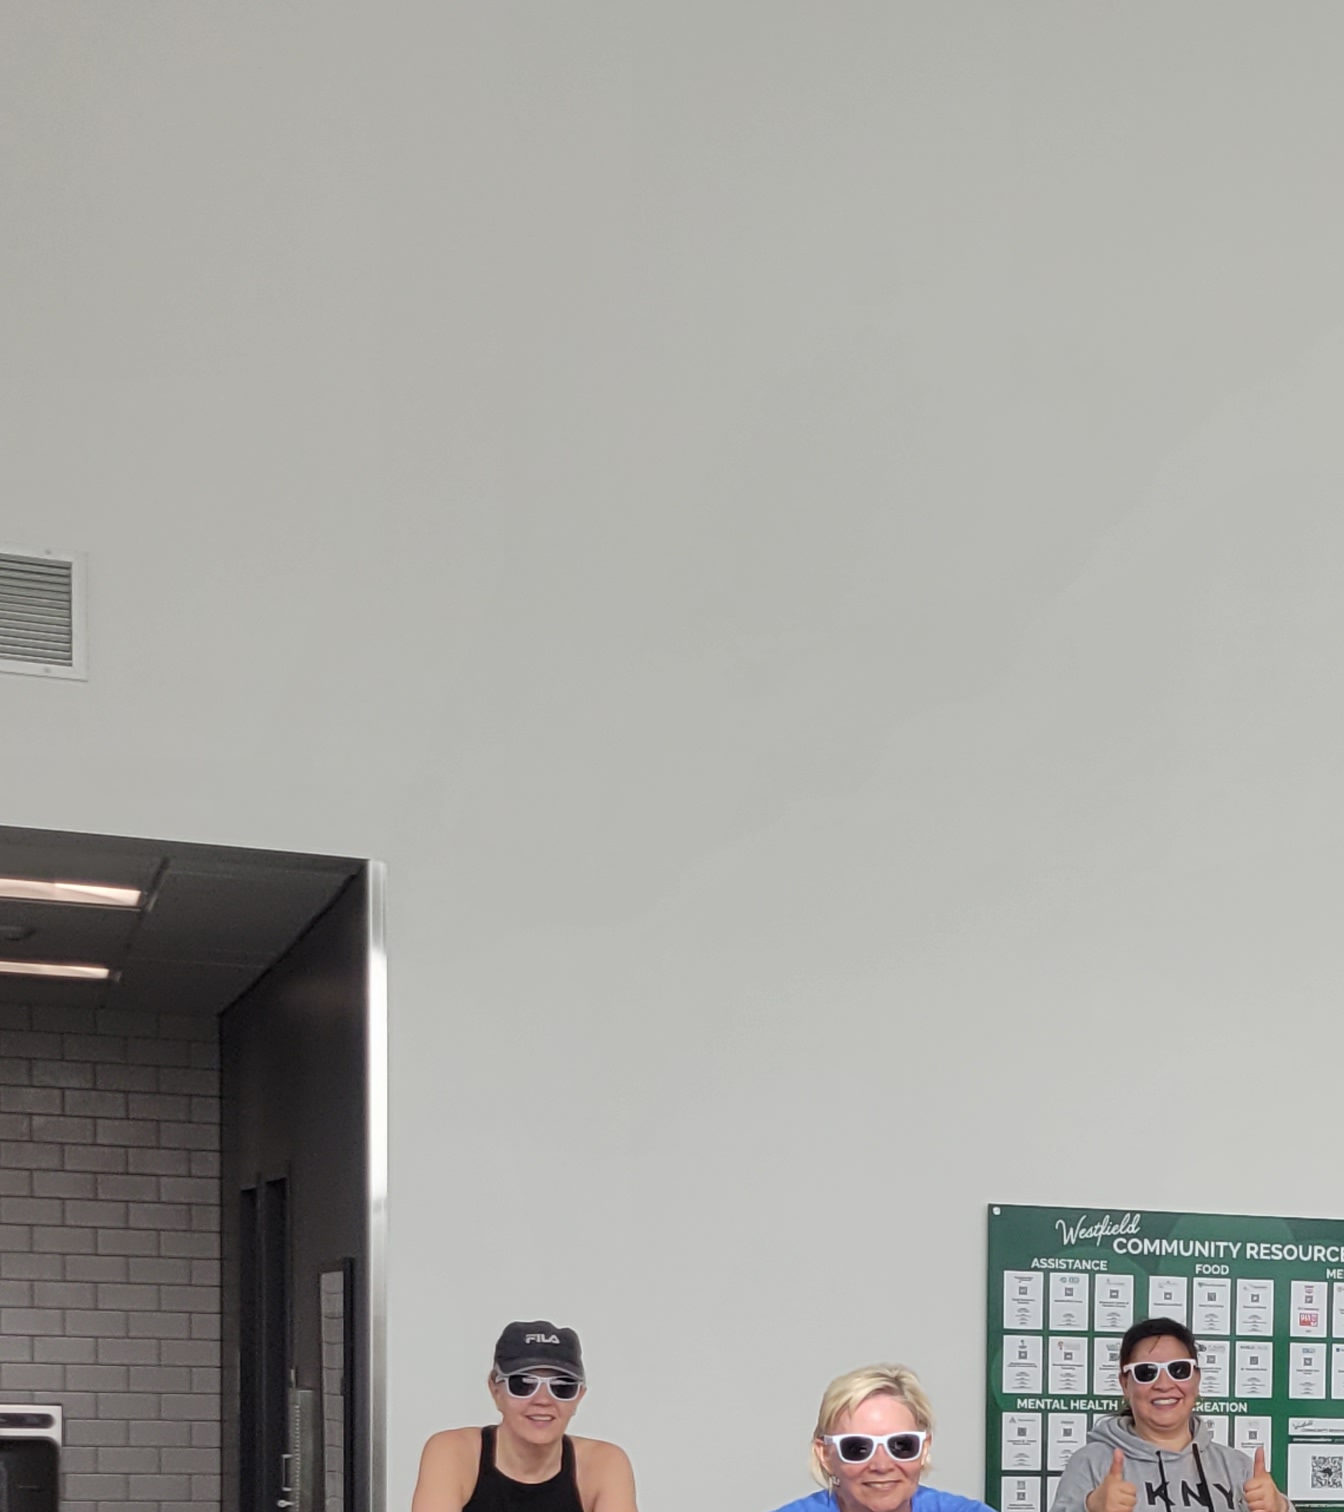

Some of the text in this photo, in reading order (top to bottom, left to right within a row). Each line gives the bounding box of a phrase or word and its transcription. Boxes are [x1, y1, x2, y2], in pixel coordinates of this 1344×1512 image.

[1055, 1212, 1141, 1247] Westfield
[1113, 1237, 1241, 1260] COMMUNITY
[1031, 1257, 1108, 1271] ASSISTANCE
[1195, 1264, 1230, 1276] FOOD
[525, 1333, 560, 1345] FILA
[1016, 1398, 1118, 1411] MENTAL HEALTH
[1192, 1401, 1248, 1413] REATION
